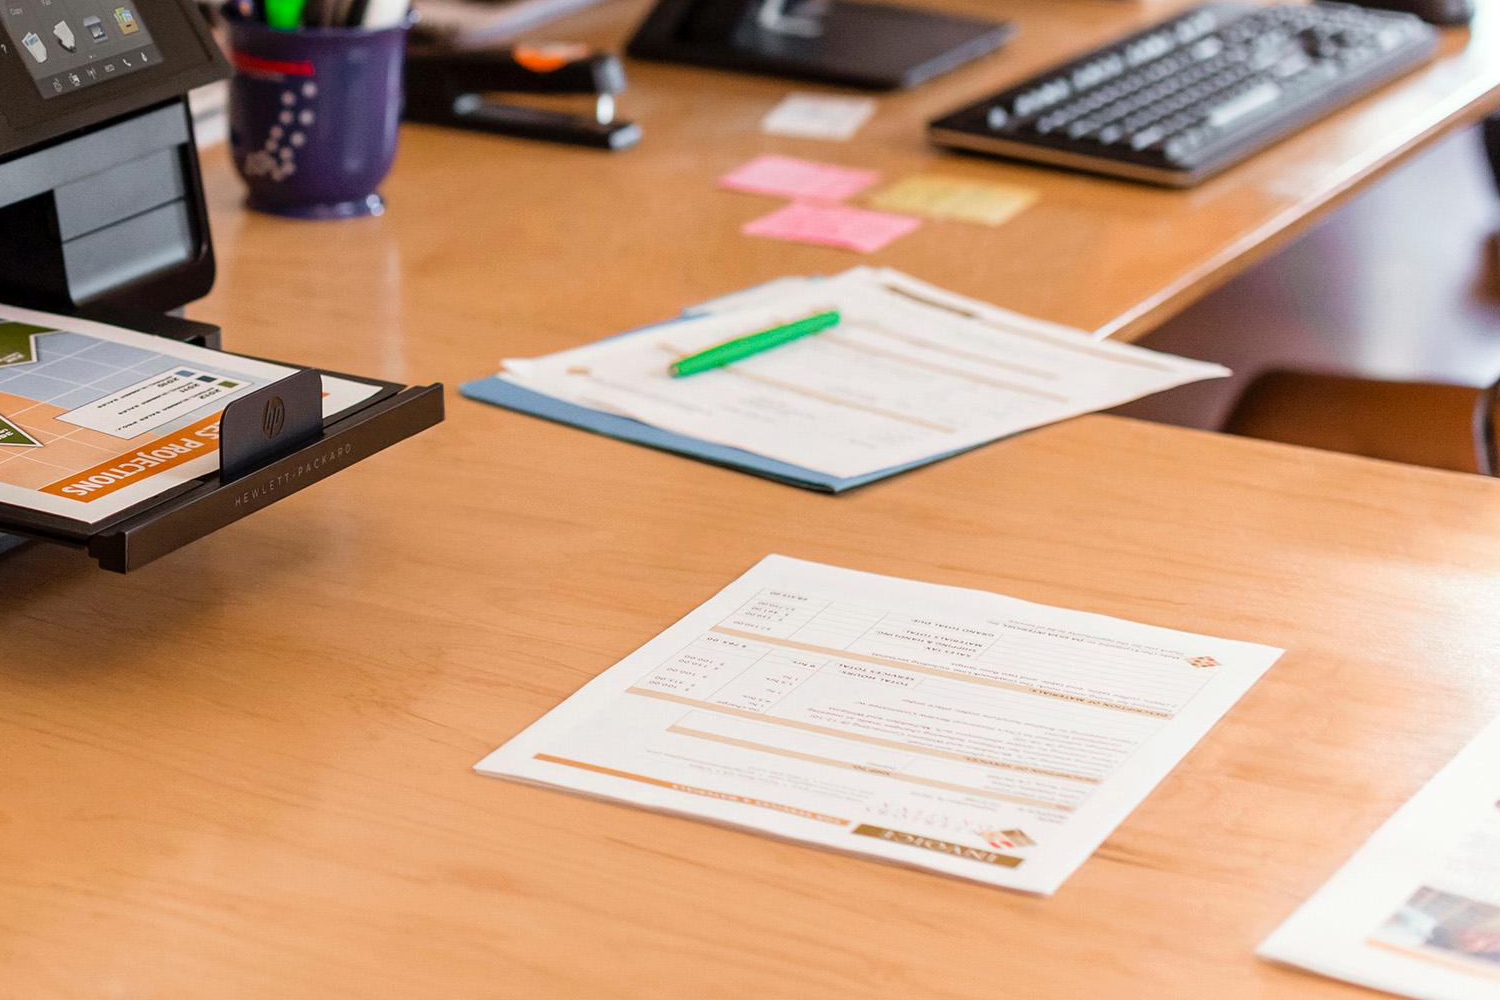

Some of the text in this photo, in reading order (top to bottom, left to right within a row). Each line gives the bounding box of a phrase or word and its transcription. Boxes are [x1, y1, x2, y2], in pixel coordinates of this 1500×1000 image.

[61, 438, 202, 497] PROJECTIONS
[234, 443, 352, 507] HEWLETT-PACKARD
[878, 677, 909, 686] TOTAL
[876, 829, 1001, 862] INVOICE
